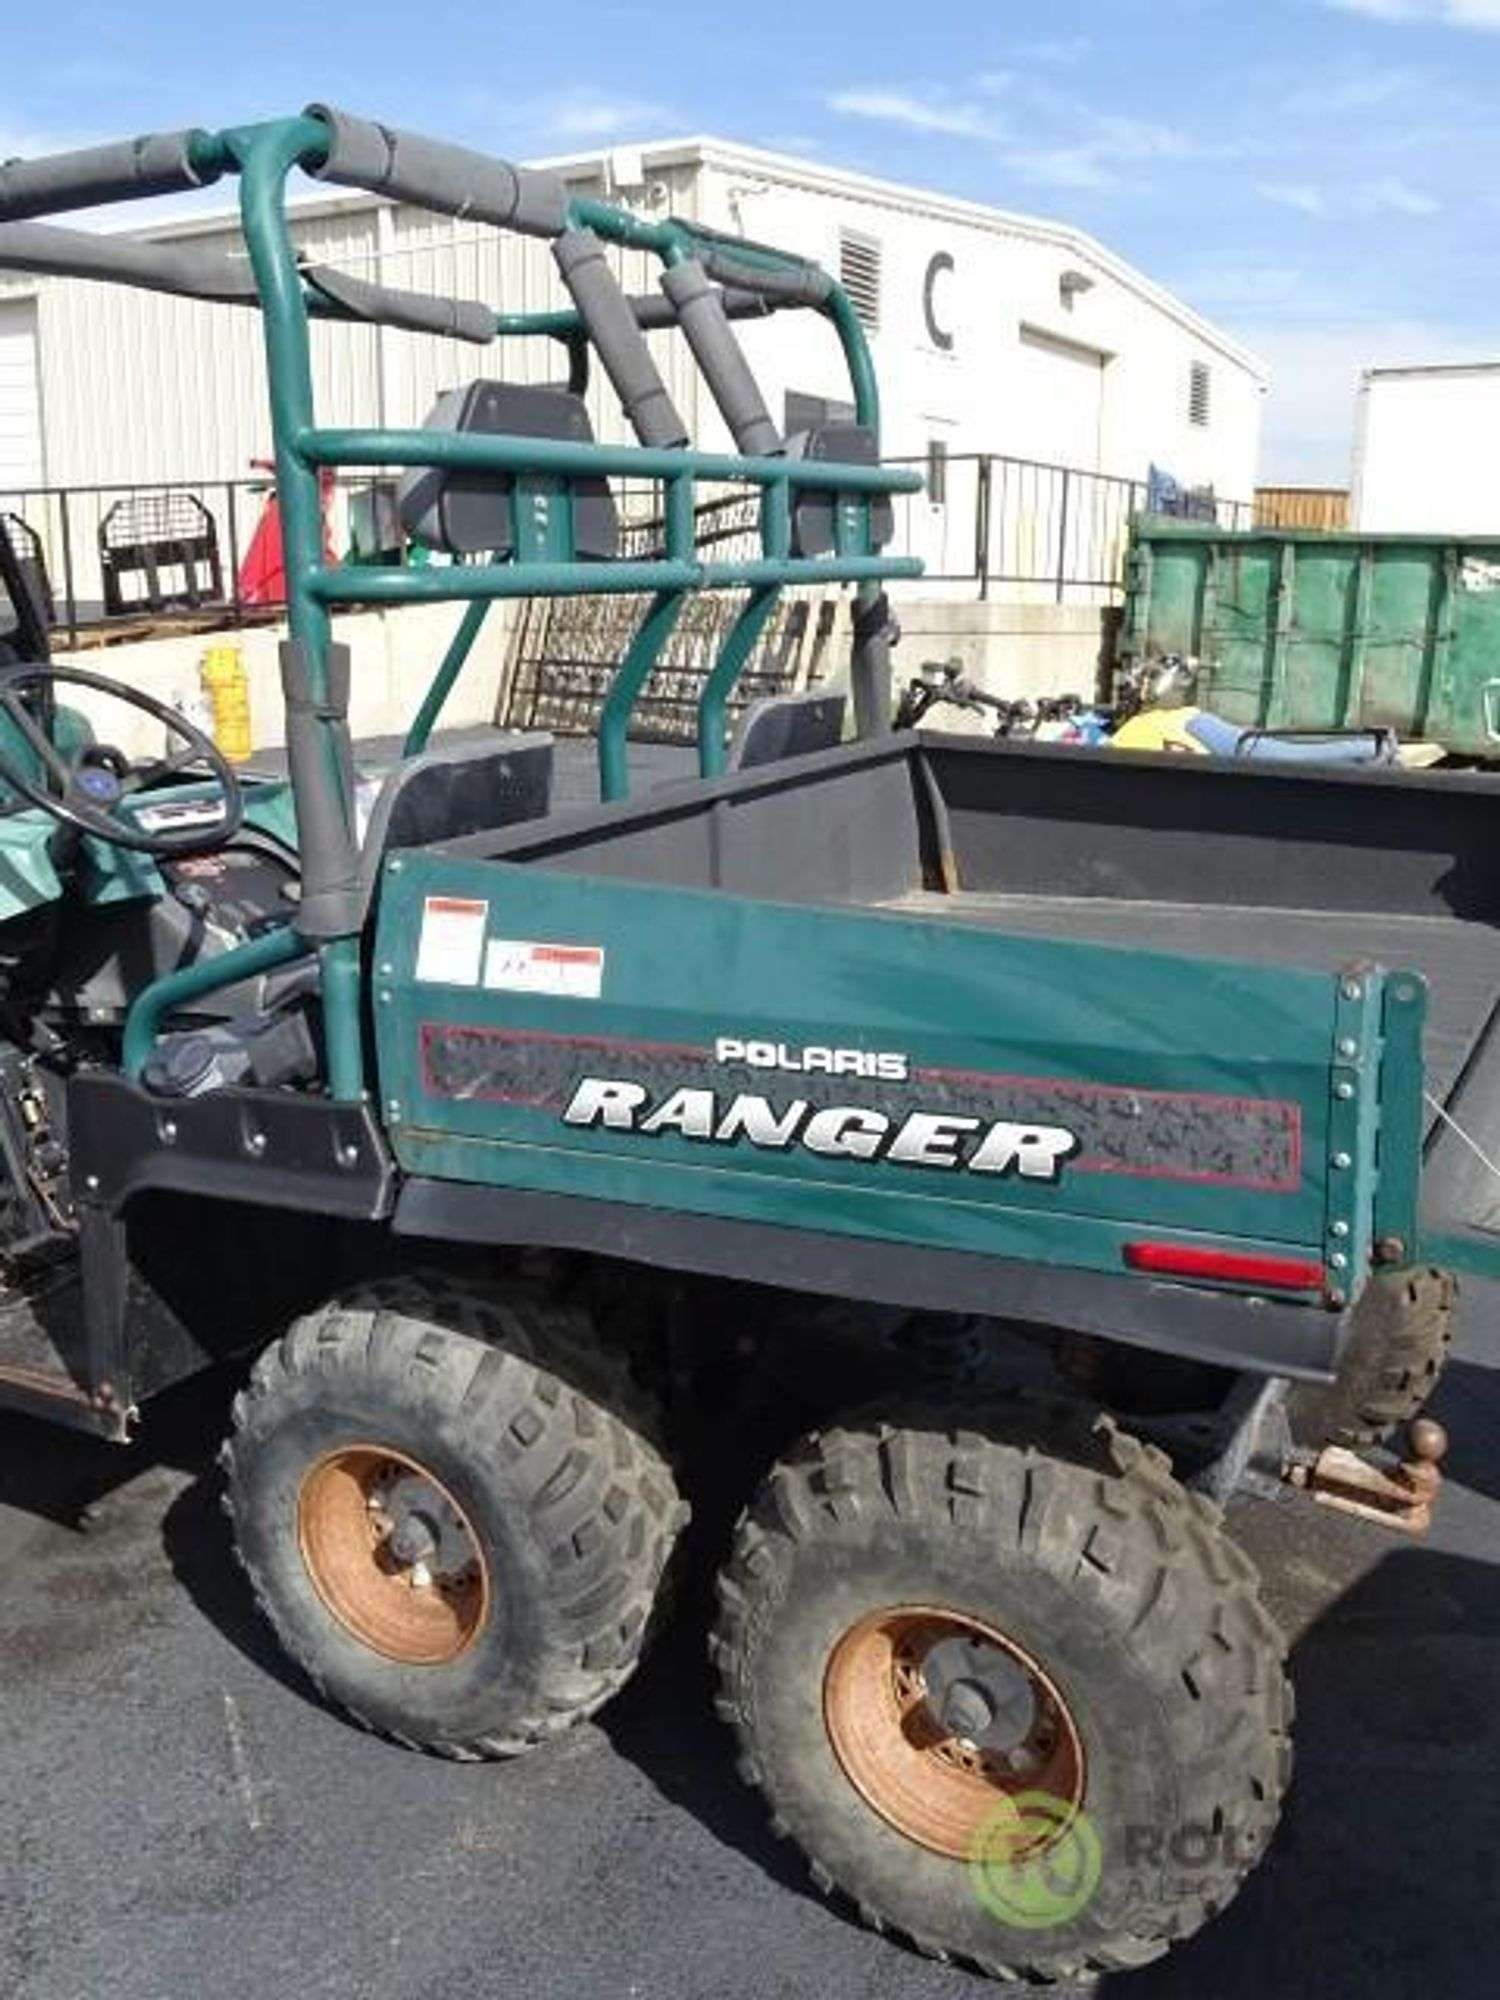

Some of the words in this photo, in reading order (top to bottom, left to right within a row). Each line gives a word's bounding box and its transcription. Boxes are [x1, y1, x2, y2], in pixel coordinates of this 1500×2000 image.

[923, 250, 954, 351] C
[715, 1037, 907, 1080] POLARIS
[563, 1077, 1077, 1181] RANGER
